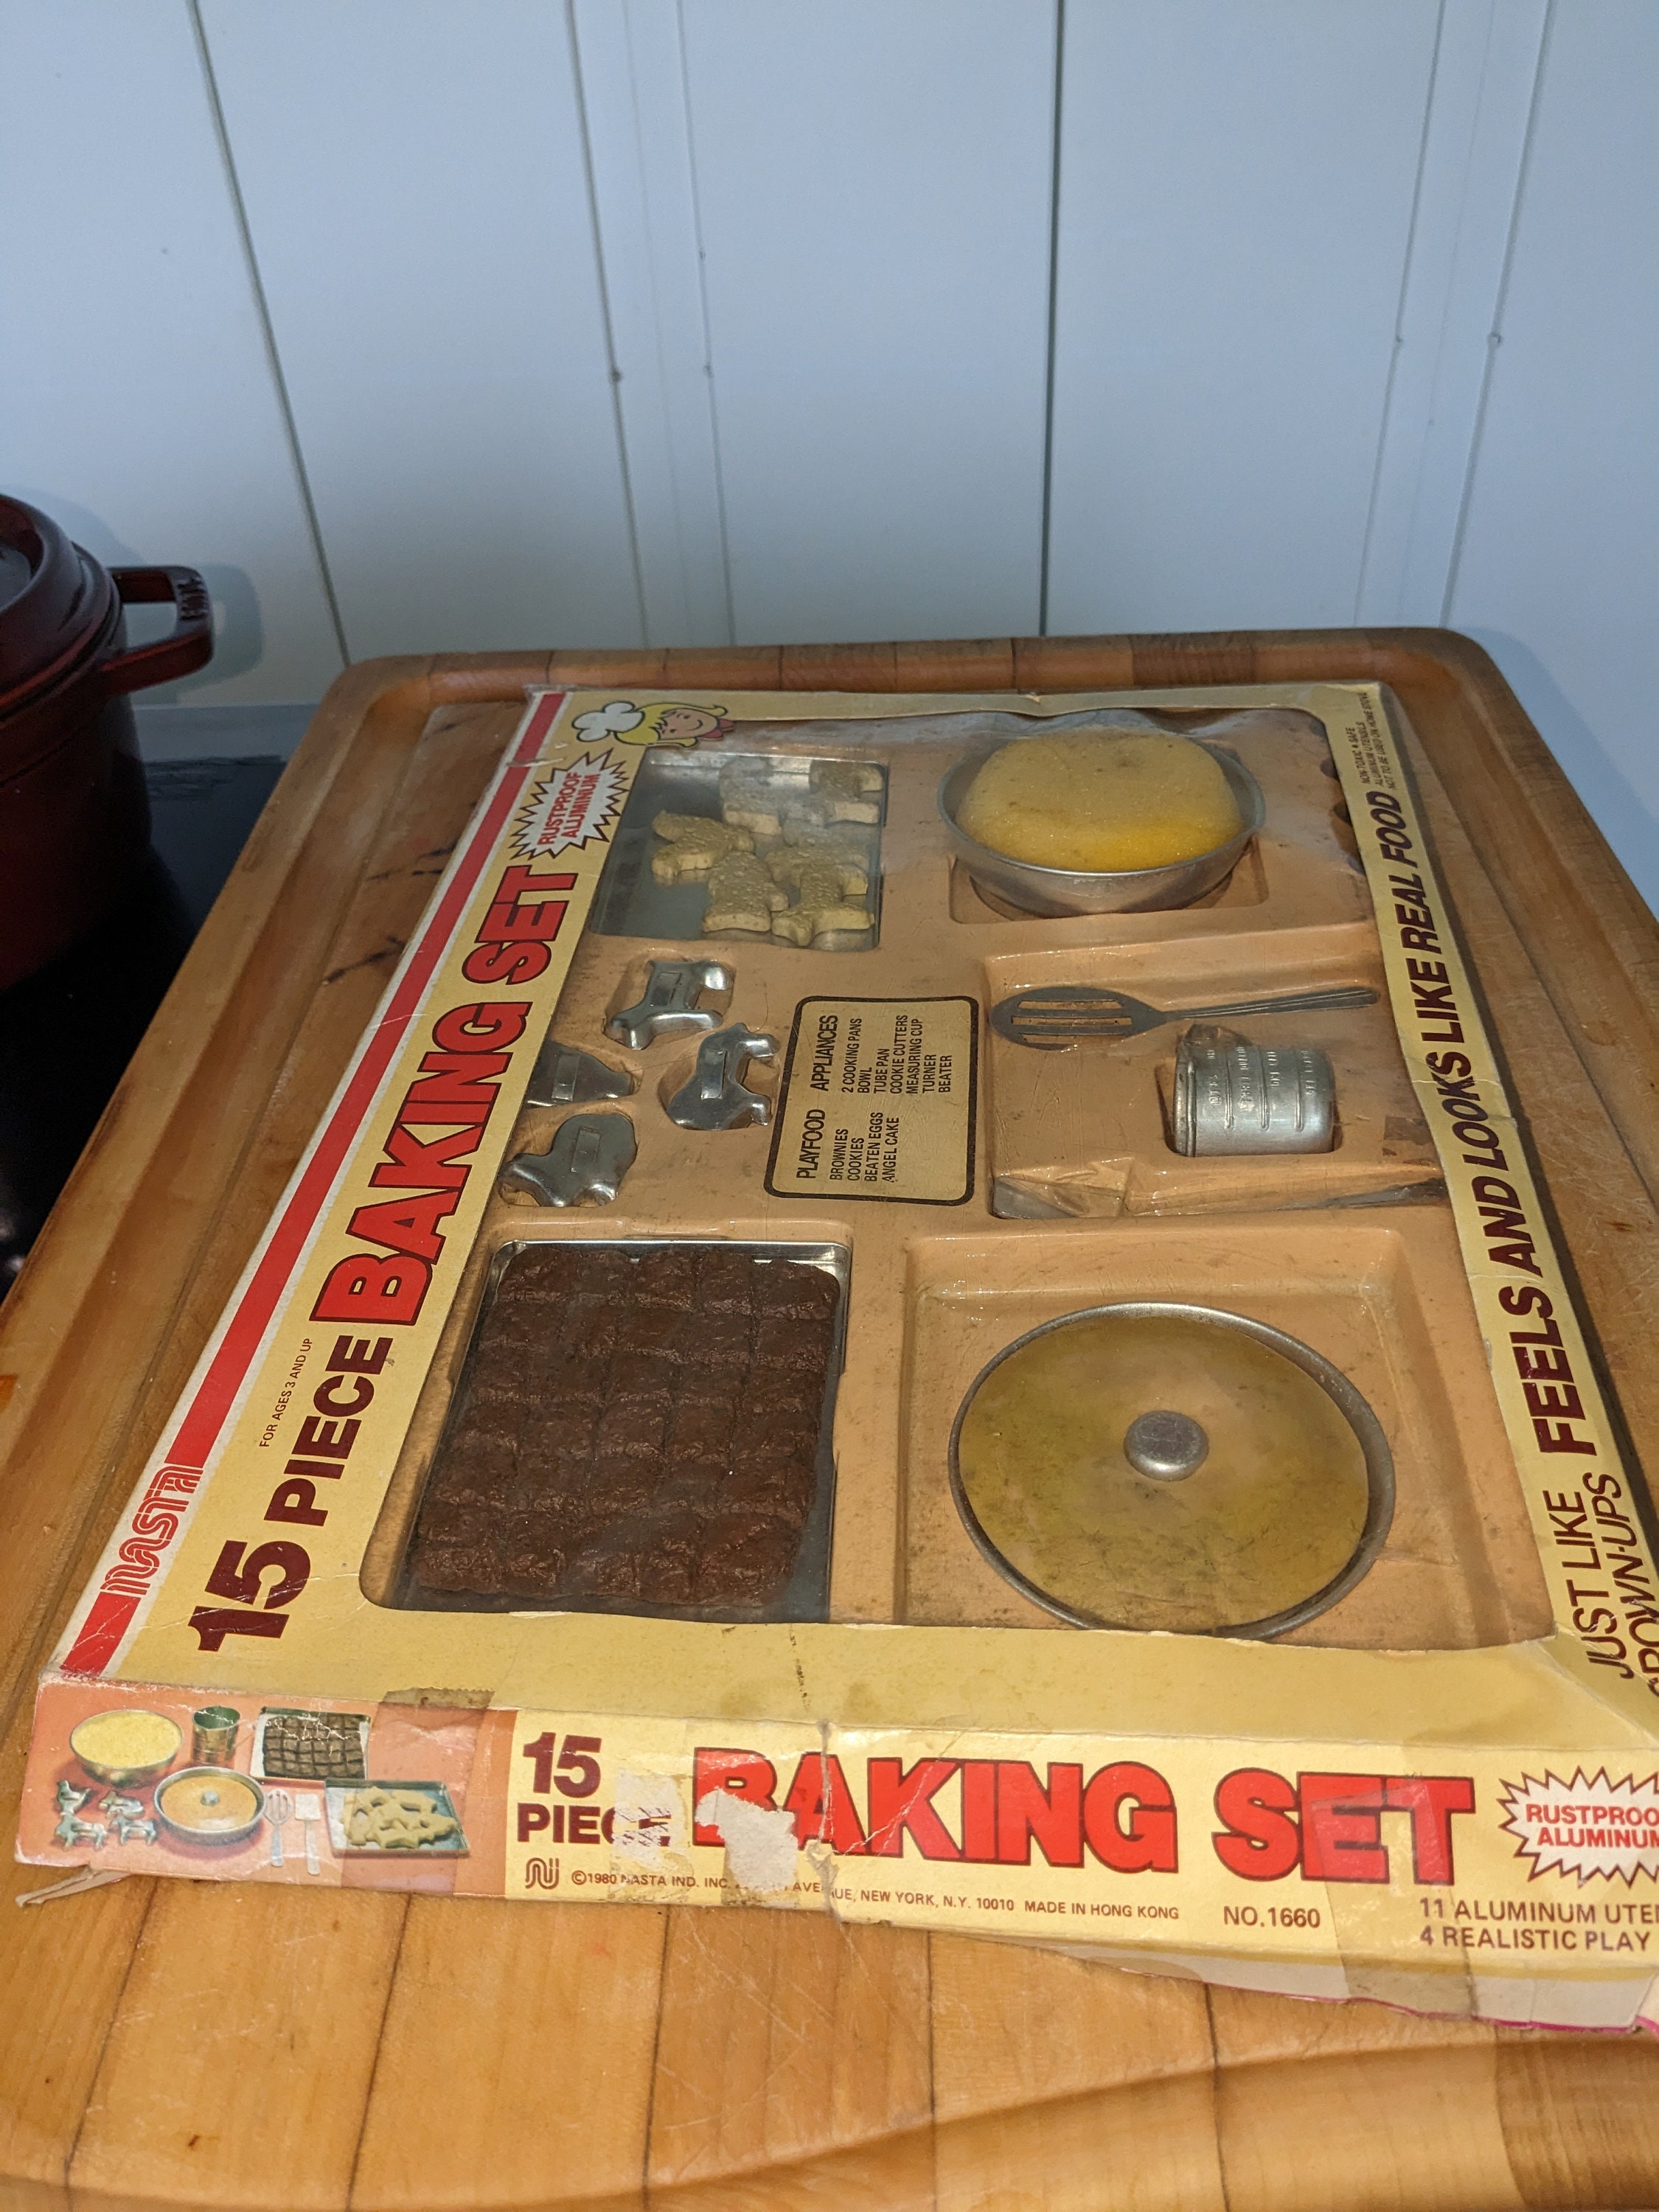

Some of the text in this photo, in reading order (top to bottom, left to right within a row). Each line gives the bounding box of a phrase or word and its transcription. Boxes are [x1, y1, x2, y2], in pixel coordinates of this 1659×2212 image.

[538, 771, 580, 846] RUSTPROOF
[561, 773, 600, 838] ALUMINUM
[810, 1015, 838, 1091] APPLIANCES
[848, 1018, 862, 1041] PANS
[890, 1015, 908, 1093] COOKIE CUTTERS
[905, 1018, 922, 1093] MEASURING CUP
[842, 1043, 860, 1085] COOKING
[857, 1067, 872, 1093] BOWL
[874, 1048, 890, 1093] TUBE PAN
[922, 1054, 936, 1093] TURNER
[939, 1055, 952, 1093] BEATER
[796, 1109, 825, 1178] PLAYFOOD
[830, 1129, 849, 1180] BROWNIES
[864, 1112, 883, 1181] BEATEN EGGS
[882, 1118, 900, 1183] ANGEL CAKE
[1366, 789, 1597, 1456] FEELS AND LOOKS LIKE REAL FOOD
[847, 1138, 864, 1180] COOKIES
[188, 865, 578, 1652] 15 PIECE BAKING SET
[260, 1424, 278, 1447] FOR
[272, 1391, 292, 1420] AGES
[290, 1354, 306, 1379] AND
[300, 1338, 313, 1352] UP
[1543, 1490, 1635, 1679] JUST LIKE
[523, 1732, 602, 1798] 15
[692, 1747, 1475, 1885] BAKING SET
[672, 1876, 699, 1888] IND.
[704, 1877, 731, 1889] INC.
[860, 1890, 891, 1902] NEW
[895, 1891, 939, 1908] YORK,
[943, 1895, 971, 1908] N.Y.
[976, 1898, 1015, 1911] 10010
[1024, 1900, 1179, 1919] MADE IN HONG KONG
[1419, 1896, 1444, 1919] 11
[1454, 1899, 1596, 1924] ALUMINUM
[1419, 1924, 1650, 1952] 4 REALISTIC PLAY
